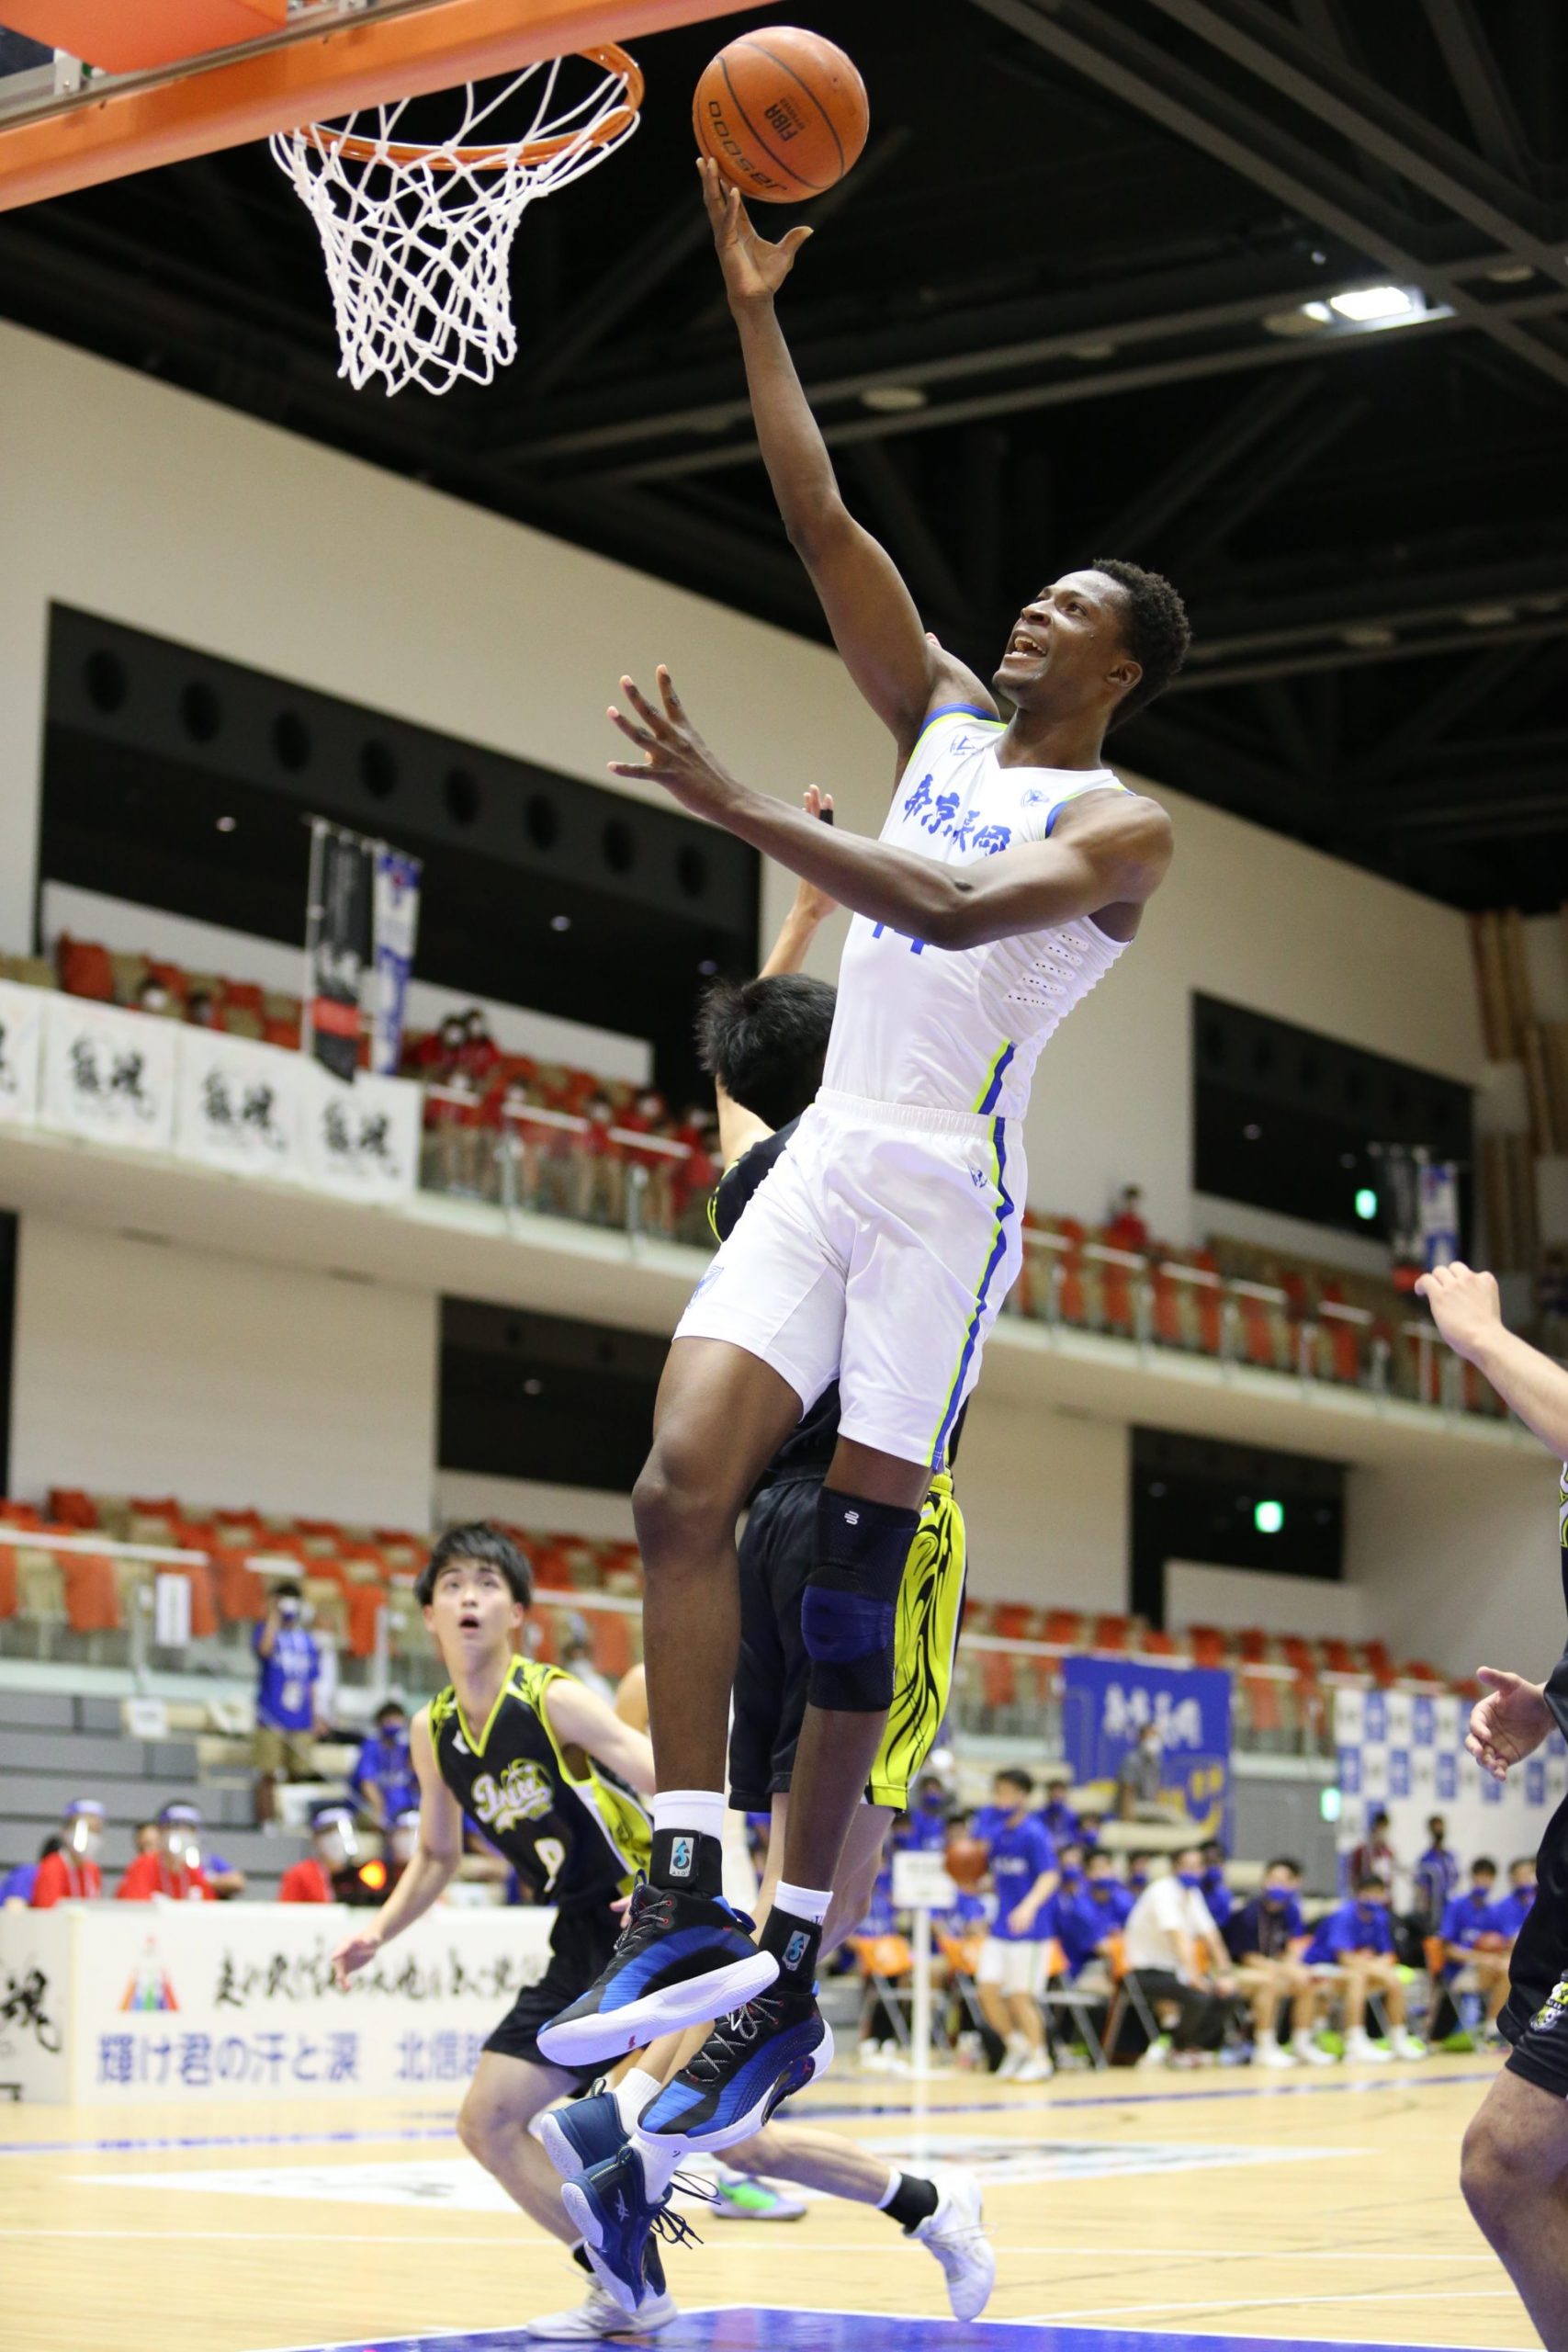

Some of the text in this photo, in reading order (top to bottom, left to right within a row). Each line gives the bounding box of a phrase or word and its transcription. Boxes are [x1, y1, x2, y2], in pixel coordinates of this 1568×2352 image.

[764, 104, 798, 141] FIBA
[98, 2031, 359, 2085] 輝け君の汗と涙
